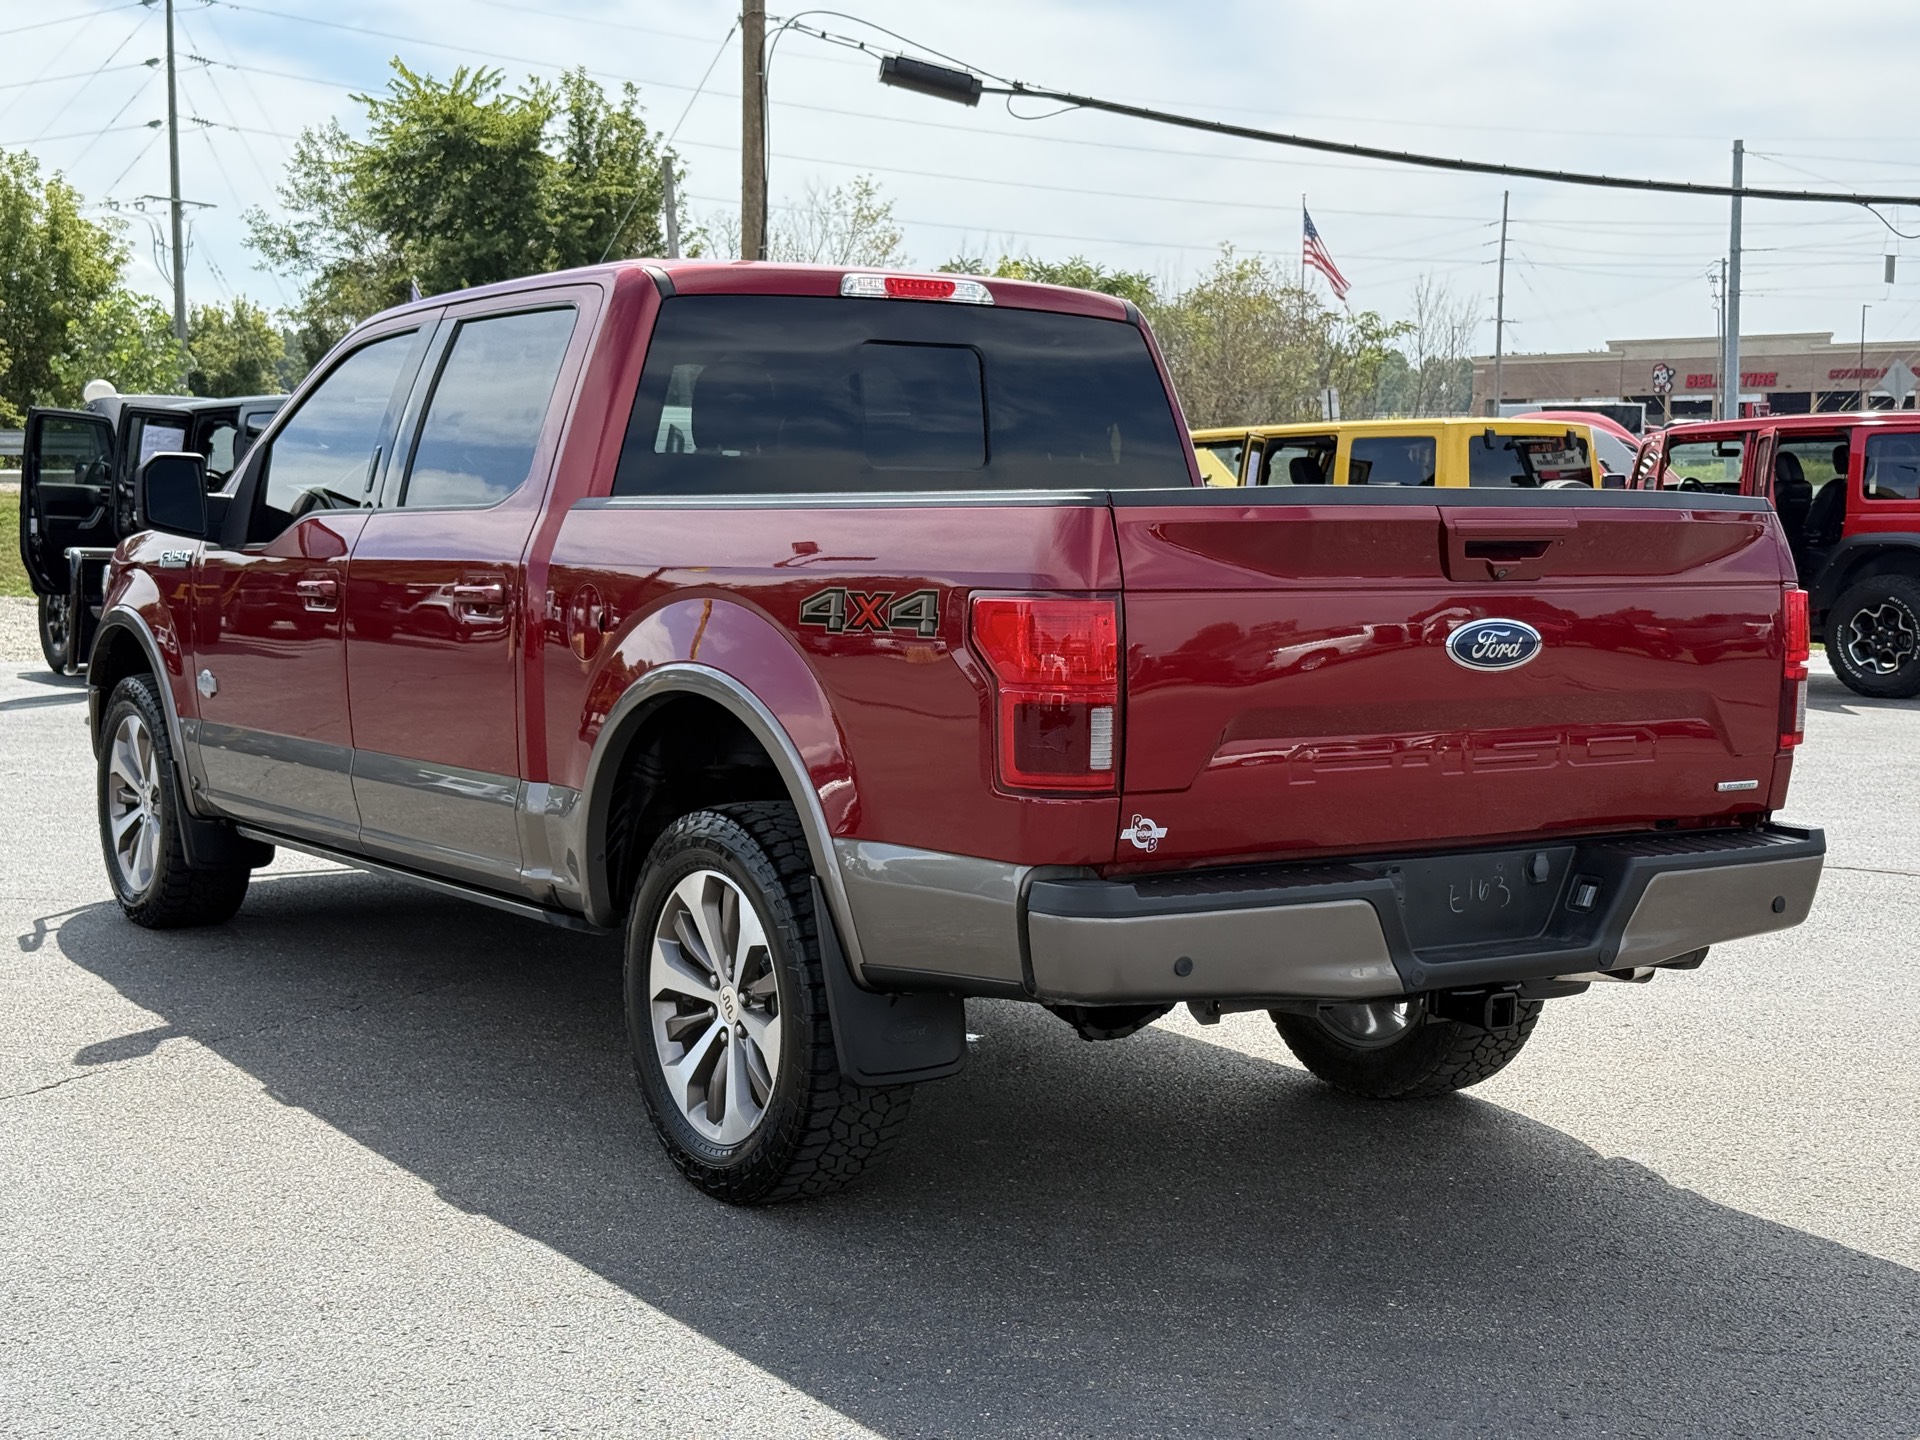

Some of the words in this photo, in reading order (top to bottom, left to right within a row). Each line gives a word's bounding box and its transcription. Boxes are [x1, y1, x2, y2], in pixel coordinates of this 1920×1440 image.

[1685, 373, 1717, 389] BEL
[1740, 372, 1777, 387] TIRE
[1471, 629, 1523, 659] Ford
